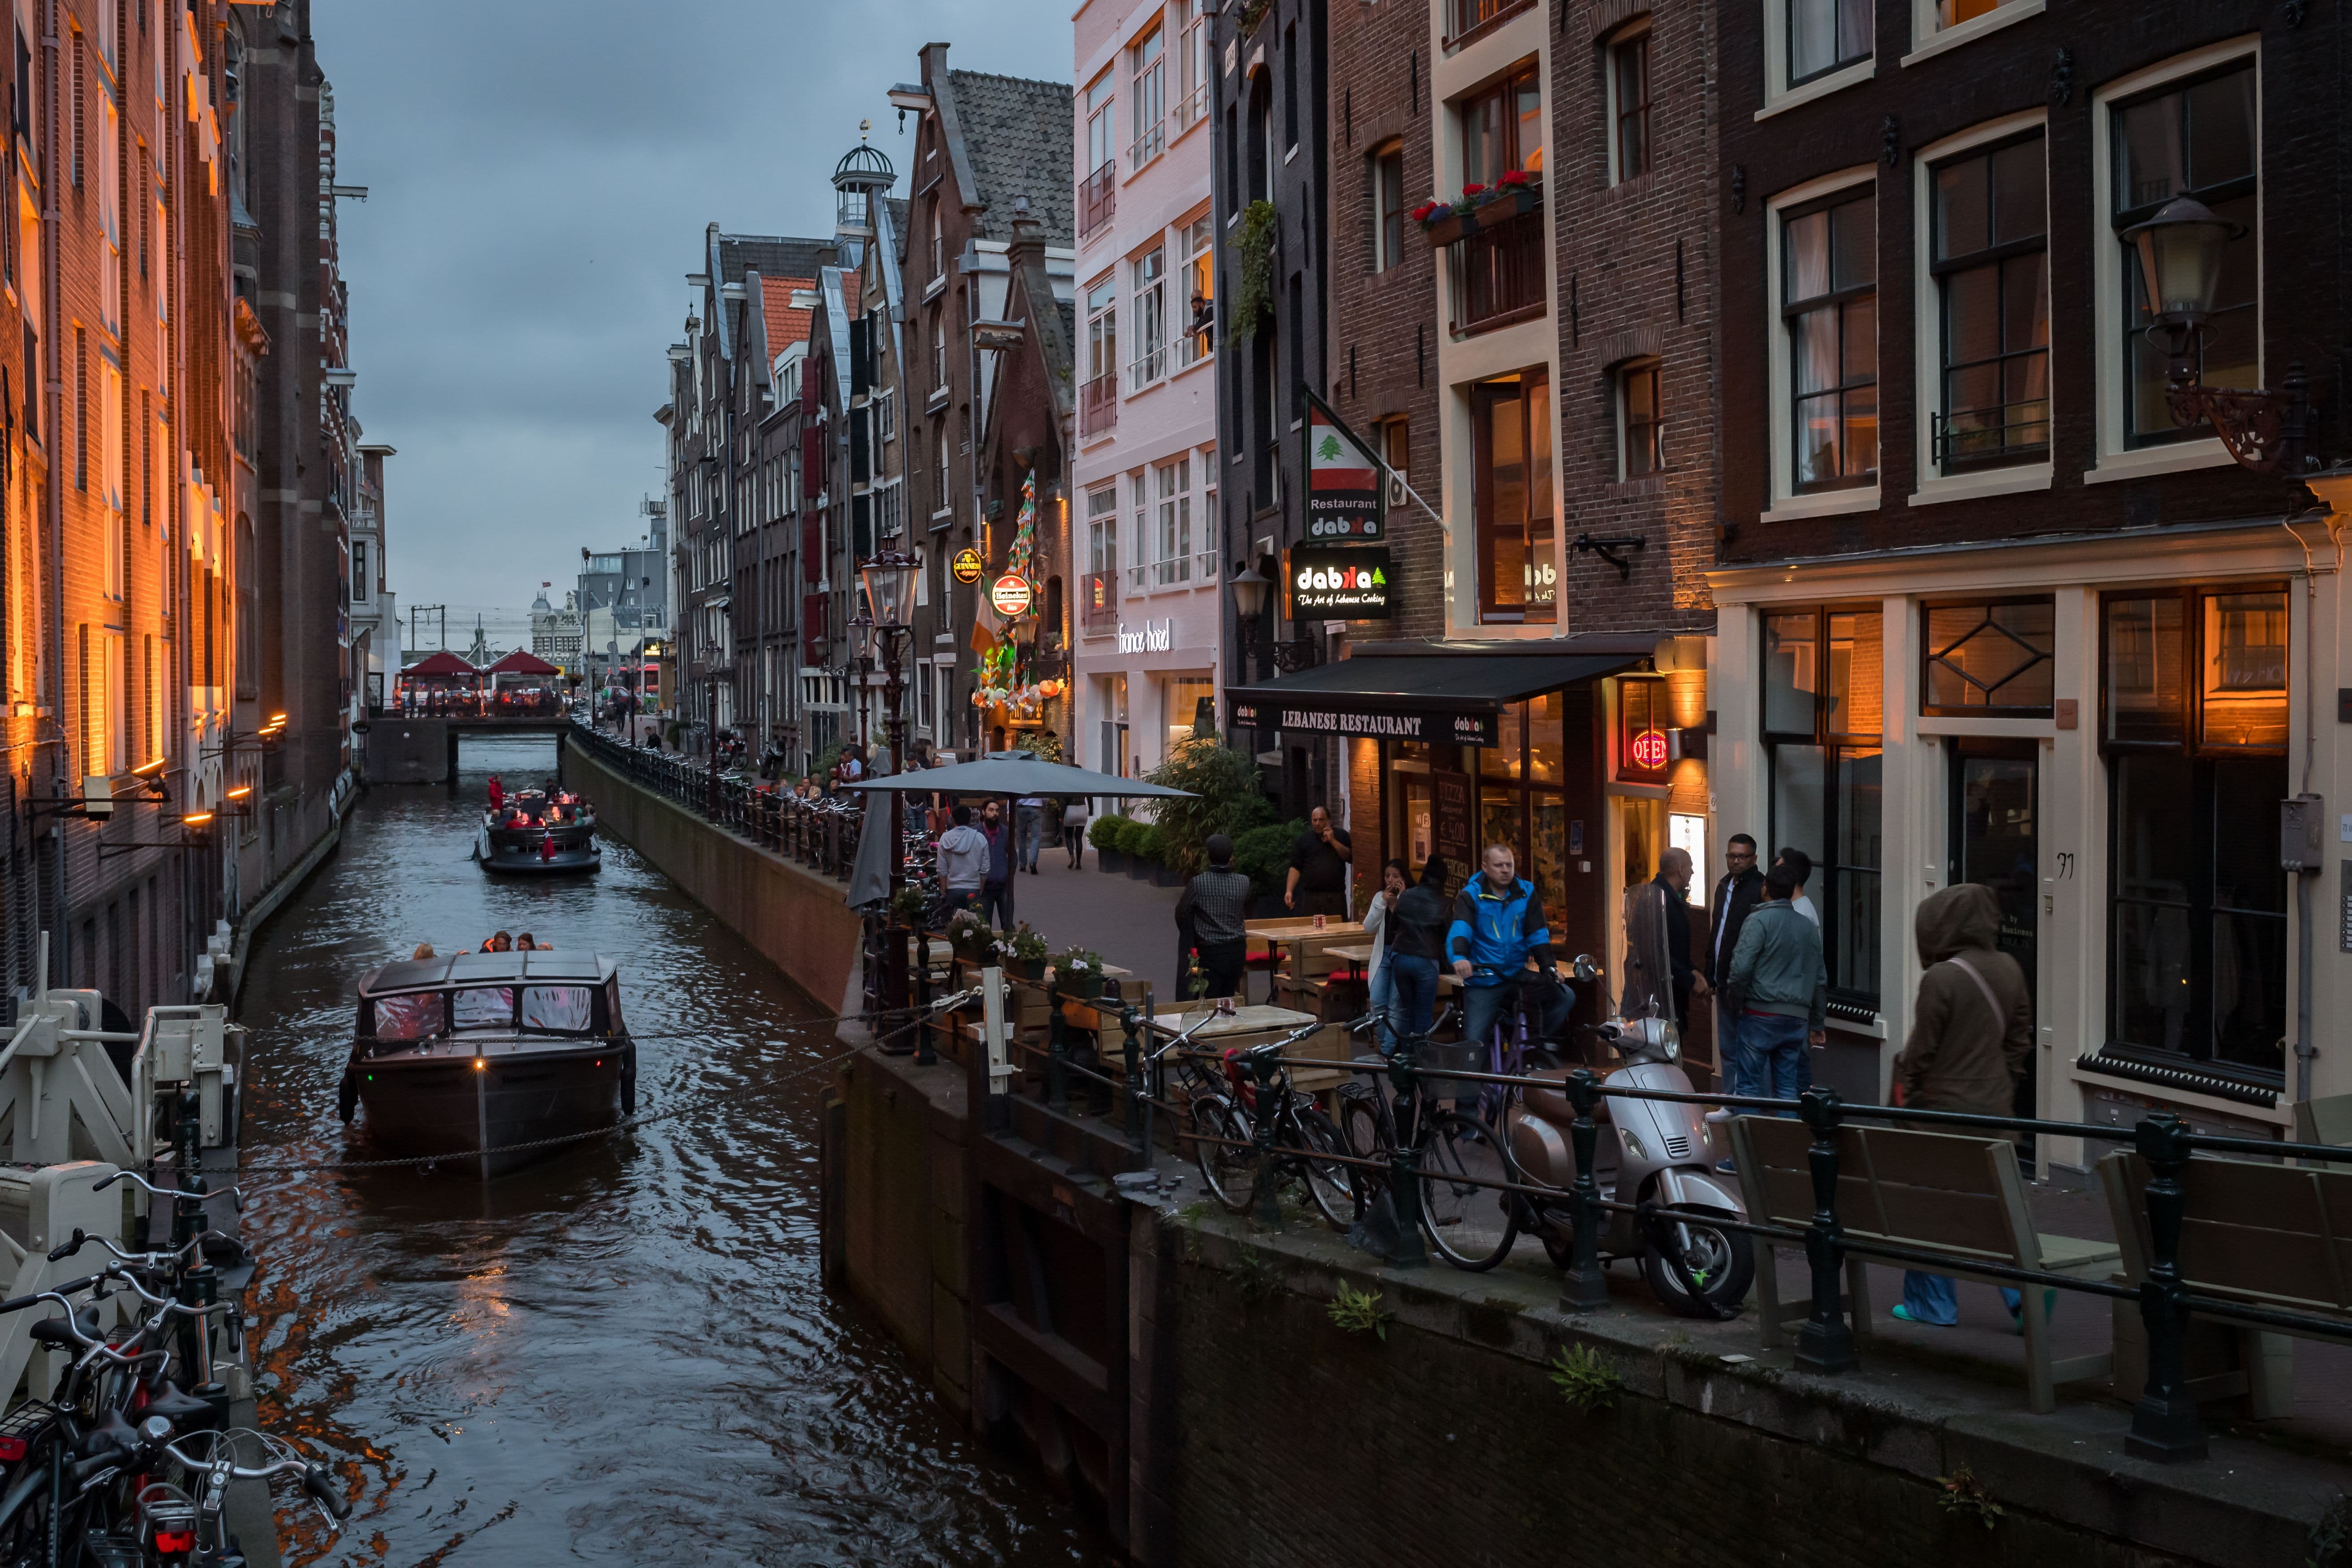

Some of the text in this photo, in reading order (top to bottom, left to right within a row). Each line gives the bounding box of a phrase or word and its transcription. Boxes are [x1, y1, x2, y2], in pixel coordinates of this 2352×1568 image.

[1311, 499, 1377, 510] Restaurant
[1312, 517, 1377, 536] dabka
[1297, 566, 1372, 590] dabka
[996, 591, 1028, 599] Heineken
[1298, 593, 1385, 607] The Art of Lebanese Cooking
[1119, 618, 1169, 654] france hotel
[1283, 711, 1422, 735] LEBANESE RESTAURANT
[1439, 781, 1465, 804] PIZZA
[1711, 797, 1717, 806] 6
[1440, 821, 1447, 836] €
[2010, 914, 2018, 924] by
[2002, 926, 2033, 937] Business
